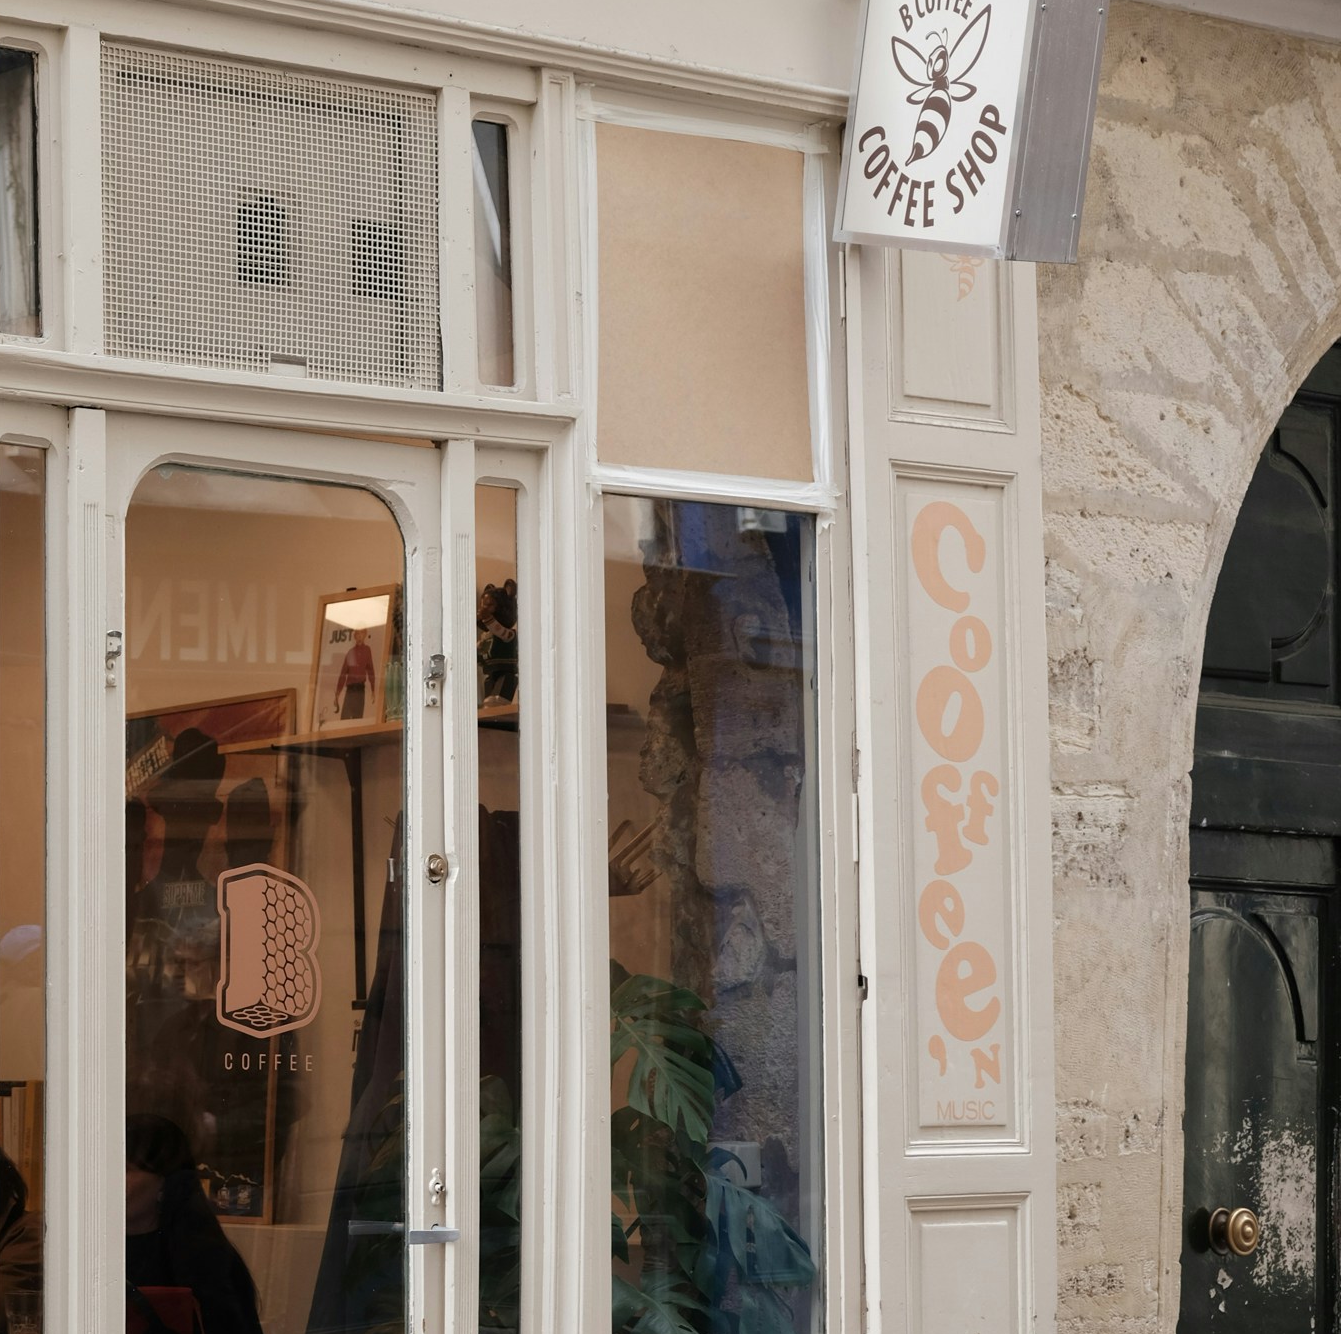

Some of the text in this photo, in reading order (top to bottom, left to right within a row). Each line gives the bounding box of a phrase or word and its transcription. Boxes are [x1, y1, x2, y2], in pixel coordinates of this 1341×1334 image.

[898, 3, 914, 33] B
[858, 104, 1007, 228] COFFEE SHOP
[329, 628, 354, 644] JUST
[224, 1052, 313, 1072] COFFEE
[936, 1100, 996, 1121] MUSIC
